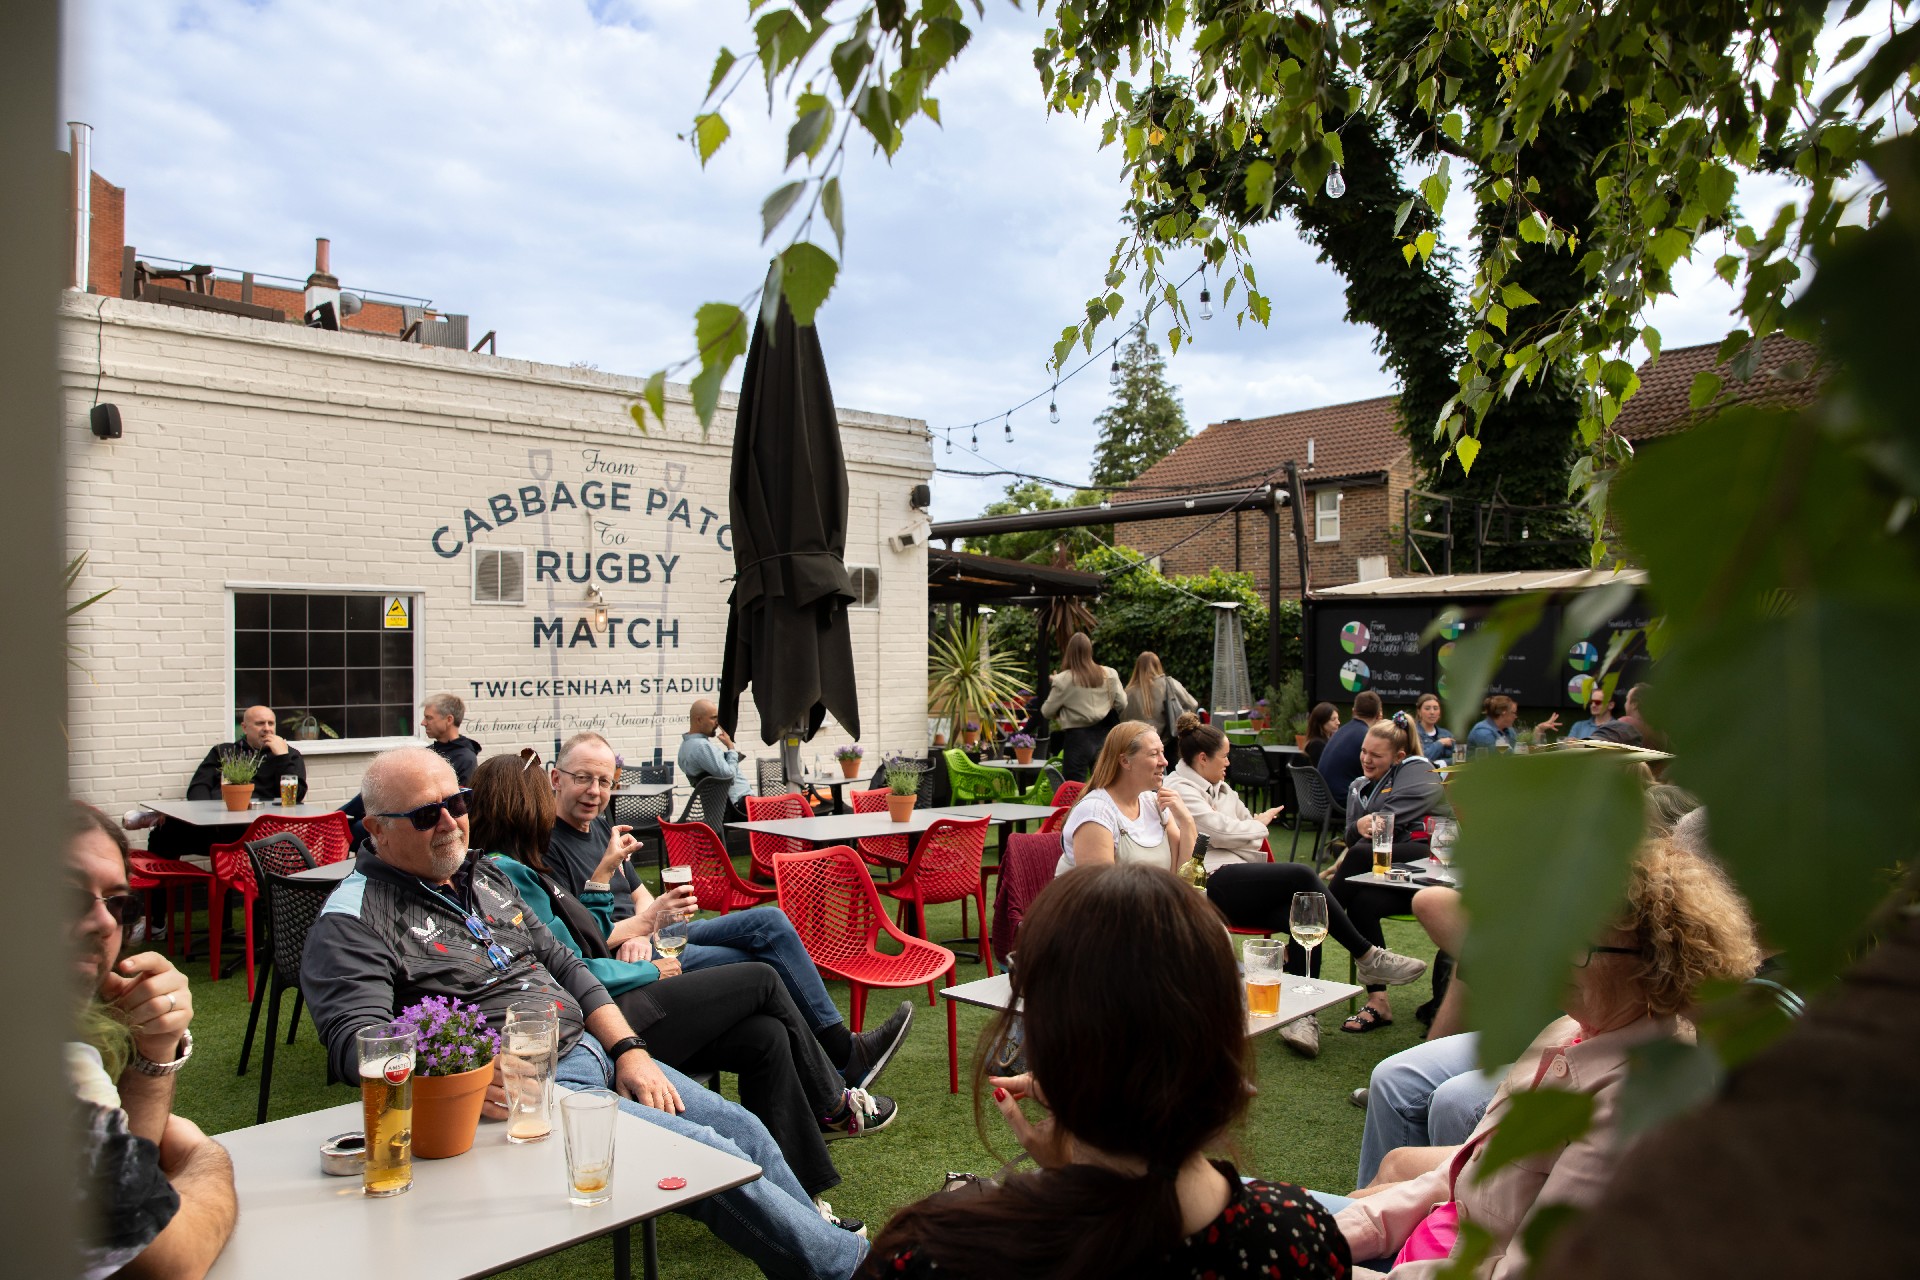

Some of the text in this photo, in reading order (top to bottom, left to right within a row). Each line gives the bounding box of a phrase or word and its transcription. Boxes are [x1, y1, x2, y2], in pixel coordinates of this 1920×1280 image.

[582, 448, 638, 475] From
[431, 480, 733, 559] CABBAGE PATC
[593, 520, 630, 545] To
[536, 550, 681, 584] RUGBY
[533, 616, 679, 649] MATCH
[470, 677, 721, 698] TWICKENHAM STADIU
[462, 718, 491, 734] The
[492, 717, 524, 732] home
[527, 715, 540, 734] of
[543, 716, 560, 730] the
[563, 713, 606, 731] Rugby
[609, 711, 649, 726] Union
[650, 711, 665, 728] for
